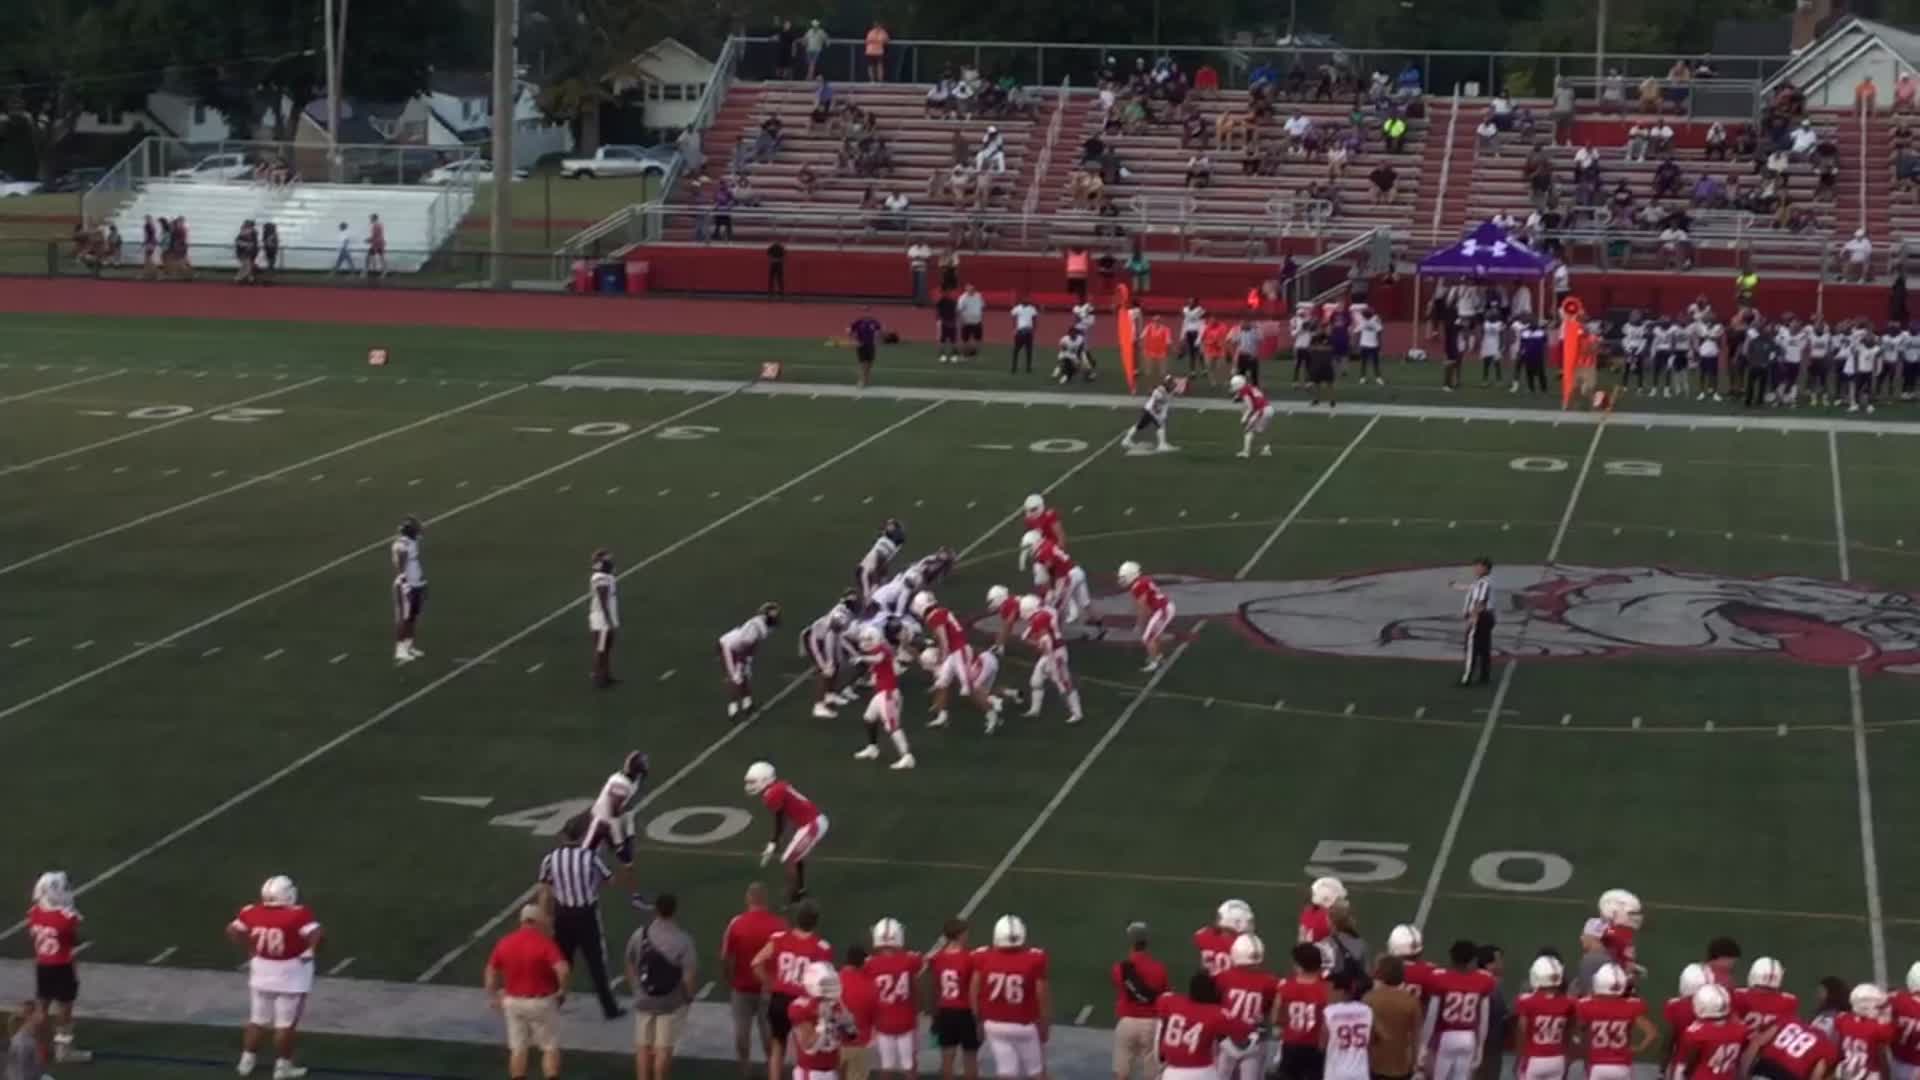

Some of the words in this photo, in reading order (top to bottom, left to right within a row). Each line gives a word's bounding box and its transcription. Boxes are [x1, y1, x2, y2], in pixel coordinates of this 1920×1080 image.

[488, 796, 752, 844] 40
[1304, 840, 1573, 891] 50
[250, 926, 284, 957] 78
[875, 971, 911, 1003] 24
[941, 968, 960, 998] 6
[987, 972, 1025, 1004] 76
[1221, 988, 1264, 1024] 70
[1443, 992, 1479, 1023] 28
[1165, 1013, 1204, 1055] 64
[1338, 1023, 1368, 1050] 95
[1592, 1020, 1628, 1049] 33
